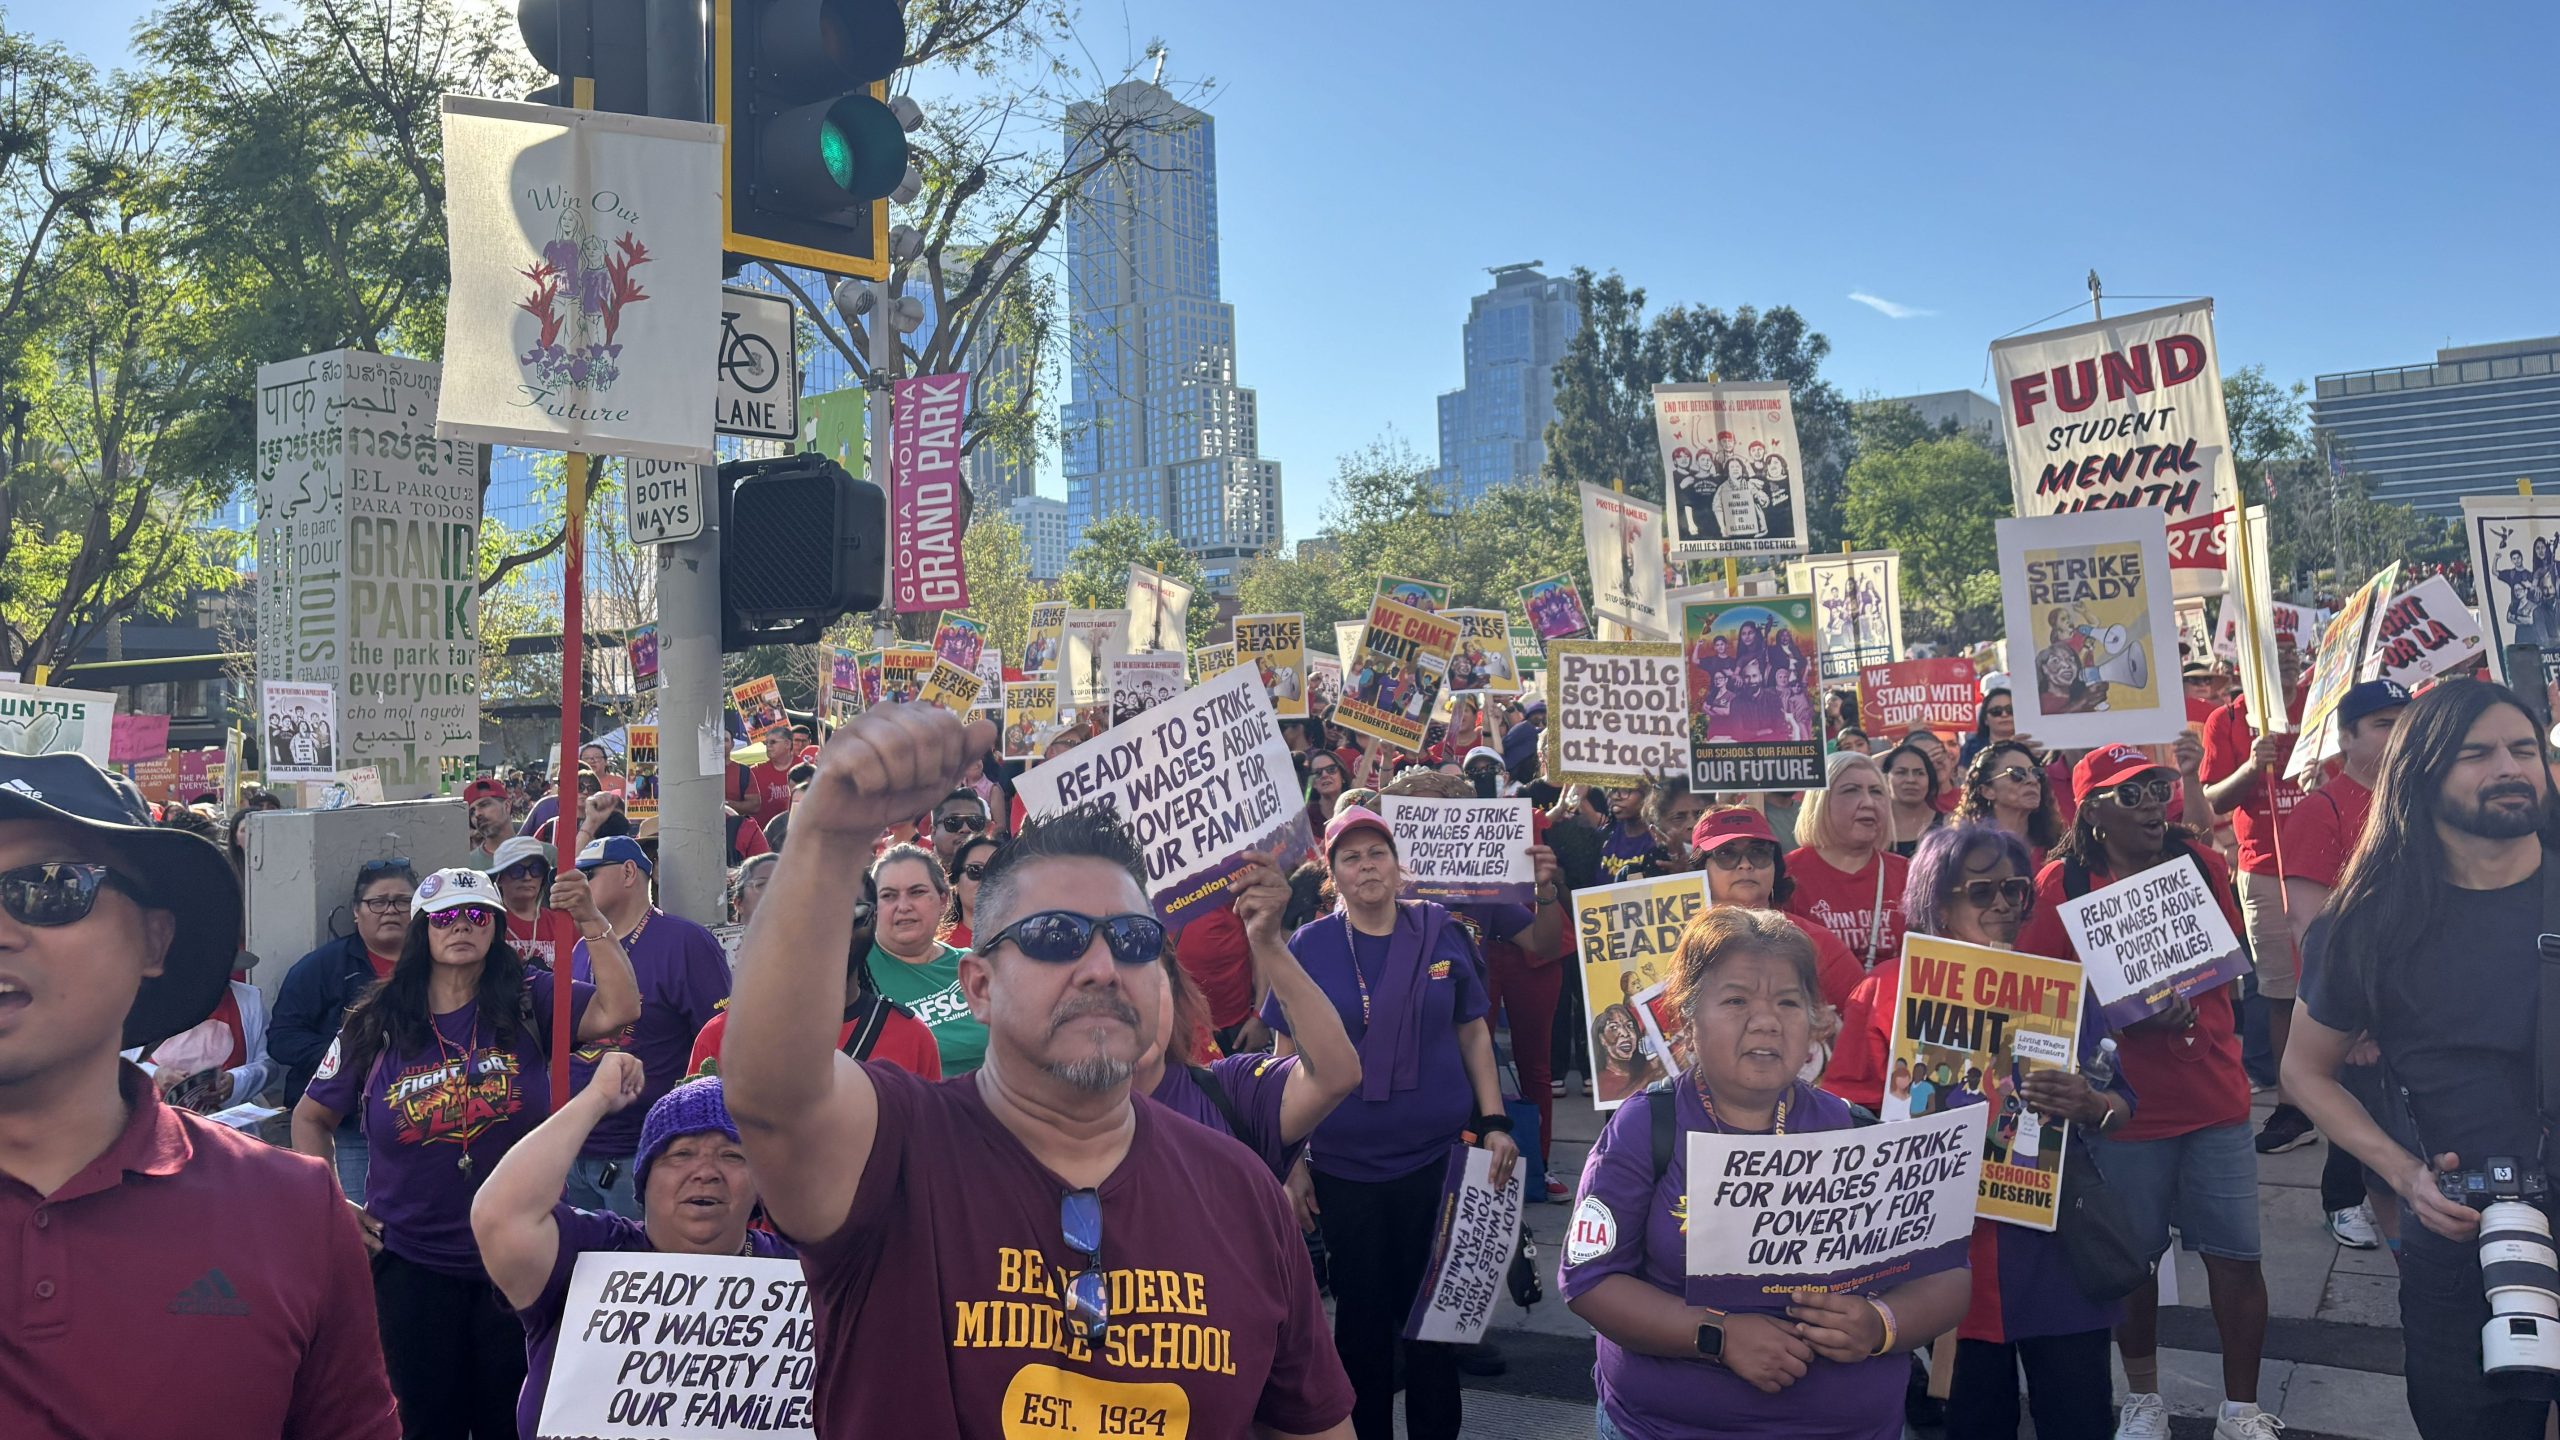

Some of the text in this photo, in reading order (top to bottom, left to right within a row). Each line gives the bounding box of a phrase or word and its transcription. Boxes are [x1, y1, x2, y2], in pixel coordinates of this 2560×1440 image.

[527, 184, 641, 225] Win Our
[2010, 334, 2208, 428] FUND
[506, 384, 630, 423] Future
[715, 398, 777, 430] LANE
[1664, 400, 1677, 413] END
[1677, 400, 1689, 412] THE
[1690, 400, 1727, 412] DETENTIONS
[1736, 398, 1781, 411] DEPORTATIONS
[2046, 407, 2176, 452] STUDENT
[458, 441, 474, 477] 2012
[2036, 438, 2203, 497] MENTAL
[351, 468, 474, 502] EL PARQUE
[636, 479, 688, 504] BOTH
[899, 384, 917, 603] GLORIA MOLINA
[916, 378, 961, 605] GRAND PARK
[351, 497, 475, 521] PARA TODOS
[636, 505, 690, 530] WAYS
[311, 519, 337, 540] parc
[1730, 524, 1755, 532] ILLEGAL!
[299, 538, 342, 567] pour
[350, 515, 475, 582] GRAND
[1680, 540, 1797, 553] FAMILIES BELONG TOGETHER
[2026, 553, 2141, 584] STRIKE
[2030, 576, 2141, 605] READY
[299, 568, 343, 663] tous
[350, 579, 475, 641] PARK
[1031, 617, 1064, 628] READY
[1032, 607, 1066, 618] STRIKE
[1236, 623, 1301, 638] STRIKE
[1372, 606, 1458, 650] WE CAN'T
[2411, 619, 2459, 651] LA
[350, 642, 476, 671] the park for
[1198, 648, 1235, 663] STRIK
[1236, 636, 1301, 652] READY
[1366, 627, 1420, 663] WAIT
[884, 655, 935, 668] WE CAN'T
[884, 668, 916, 681] WAIT
[1200, 657, 1235, 674] READ
[1563, 656, 1680, 686] Public
[1823, 658, 1847, 676] OUR
[350, 671, 476, 703] everyone
[929, 675, 976, 702] READY
[934, 665, 980, 693] STRIKE
[1866, 668, 1891, 686] WE
[2383, 681, 2405, 698] LA
[1007, 687, 1056, 699] STRIKE
[1007, 698, 1056, 709] READY
[1877, 683, 1972, 707] STAND WITH
[347, 703, 465, 722] cho mọi người
[1338, 705, 1422, 742] OUR STUDENTS DESERVE
[1884, 702, 1972, 726] EDUCATORS
[631, 732, 653, 747] WE
[1056, 681, 1256, 806] READY TO STRIKE
[1562, 736, 1688, 770] attack
[1696, 745, 1818, 759] OUR SCHOOLS. OUR FAMILIES.
[1126, 711, 1272, 811] WAGES ABOVE
[1237, 753, 1270, 792] FOR
[1697, 758, 1820, 783] OUR FUTURE.
[1396, 804, 1520, 823] READY TO STRIKE
[1393, 823, 1526, 841] FOR WAGES ABOVE
[1410, 841, 1506, 859] POVERTY FOR
[1410, 858, 1437, 876] OUR
[1165, 876, 1228, 916] education
[2080, 868, 2192, 928] READY TO STRIKE
[1580, 892, 1702, 936] STRIKE
[1822, 911, 1857, 929] WIN
[2086, 886, 2206, 950] FOR WAGES ABOVE
[2115, 914, 2201, 965] POVERTY FOR
[1910, 955, 2077, 1020] WE CAN'T
[2124, 960, 2151, 986] OUR
[905, 996, 927, 1007] District
[909, 993, 969, 1023] AFSC
[1906, 997, 2011, 1055] WAIT
[2016, 1043, 2068, 1060] for Educators
[2018, 1034, 2067, 1052] Living Wages
[397, 1066, 460, 1101] FIGHT
[1777, 1100, 1786, 1121] SEIU
[1724, 1124, 1970, 1178] READY TO STRIKE
[1714, 1150, 1972, 1209] FOR WAGES ABOVE
[1984, 1164, 2051, 1189] SCHOOLS
[1460, 1185, 1480, 1225] OUR
[1585, 1203, 1607, 1220] TEACHERS
[1988, 1185, 2053, 1209] DESERVE
[1752, 1188, 1936, 1238] POVERTY FOR
[1449, 1189, 1492, 1311] POVERTY FOR
[1469, 1176, 1520, 1331] READY TO STRIKE
[1748, 1238, 1808, 1267] OUR
[1454, 1212, 1502, 1335] WAGES ABOVE
[1762, 1283, 1828, 1294] education
[1829, 1273, 1875, 1292] workers
[1875, 1261, 1911, 1281] united
[600, 1270, 708, 1307] READY
[714, 1276, 756, 1311] TO
[583, 1309, 651, 1345] FOR
[654, 1312, 769, 1348] WAGES
[953, 1301, 1237, 1376] MIDDLE SCHOOL
[617, 1350, 770, 1390] POVERTY
[607, 1388, 679, 1427] OUR
[1019, 1392, 1167, 1437] EST. 1924
